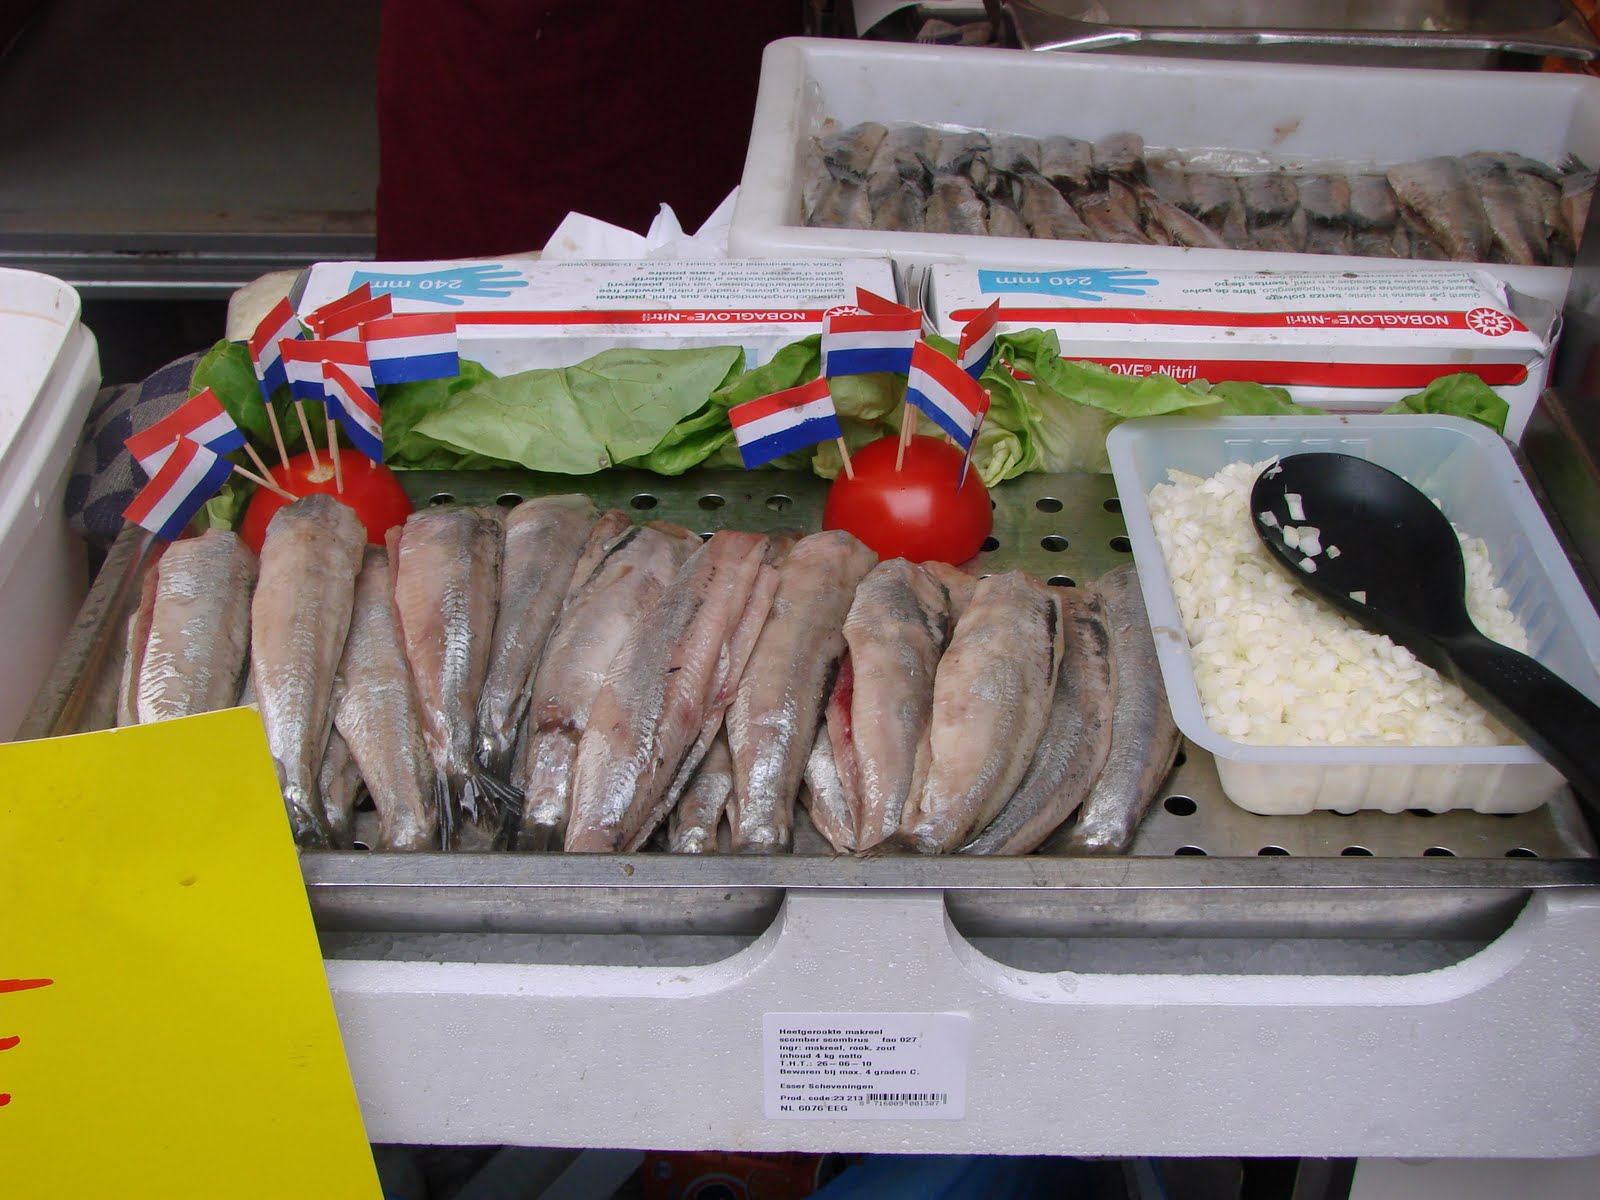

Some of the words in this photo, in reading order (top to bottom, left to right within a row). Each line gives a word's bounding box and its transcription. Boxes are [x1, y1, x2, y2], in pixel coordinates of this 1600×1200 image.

[369, 280, 411, 289] mm
[419, 279, 463, 290] 240
[996, 276, 1041, 285] mm
[1049, 276, 1093, 286] 240
[1285, 314, 1450, 325] NOBAGLOVE®-Nitril
[824, 1068, 836, 1076] bij
[873, 1068, 907, 1076] graden
[808, 1082, 874, 1090] Scheveningen
